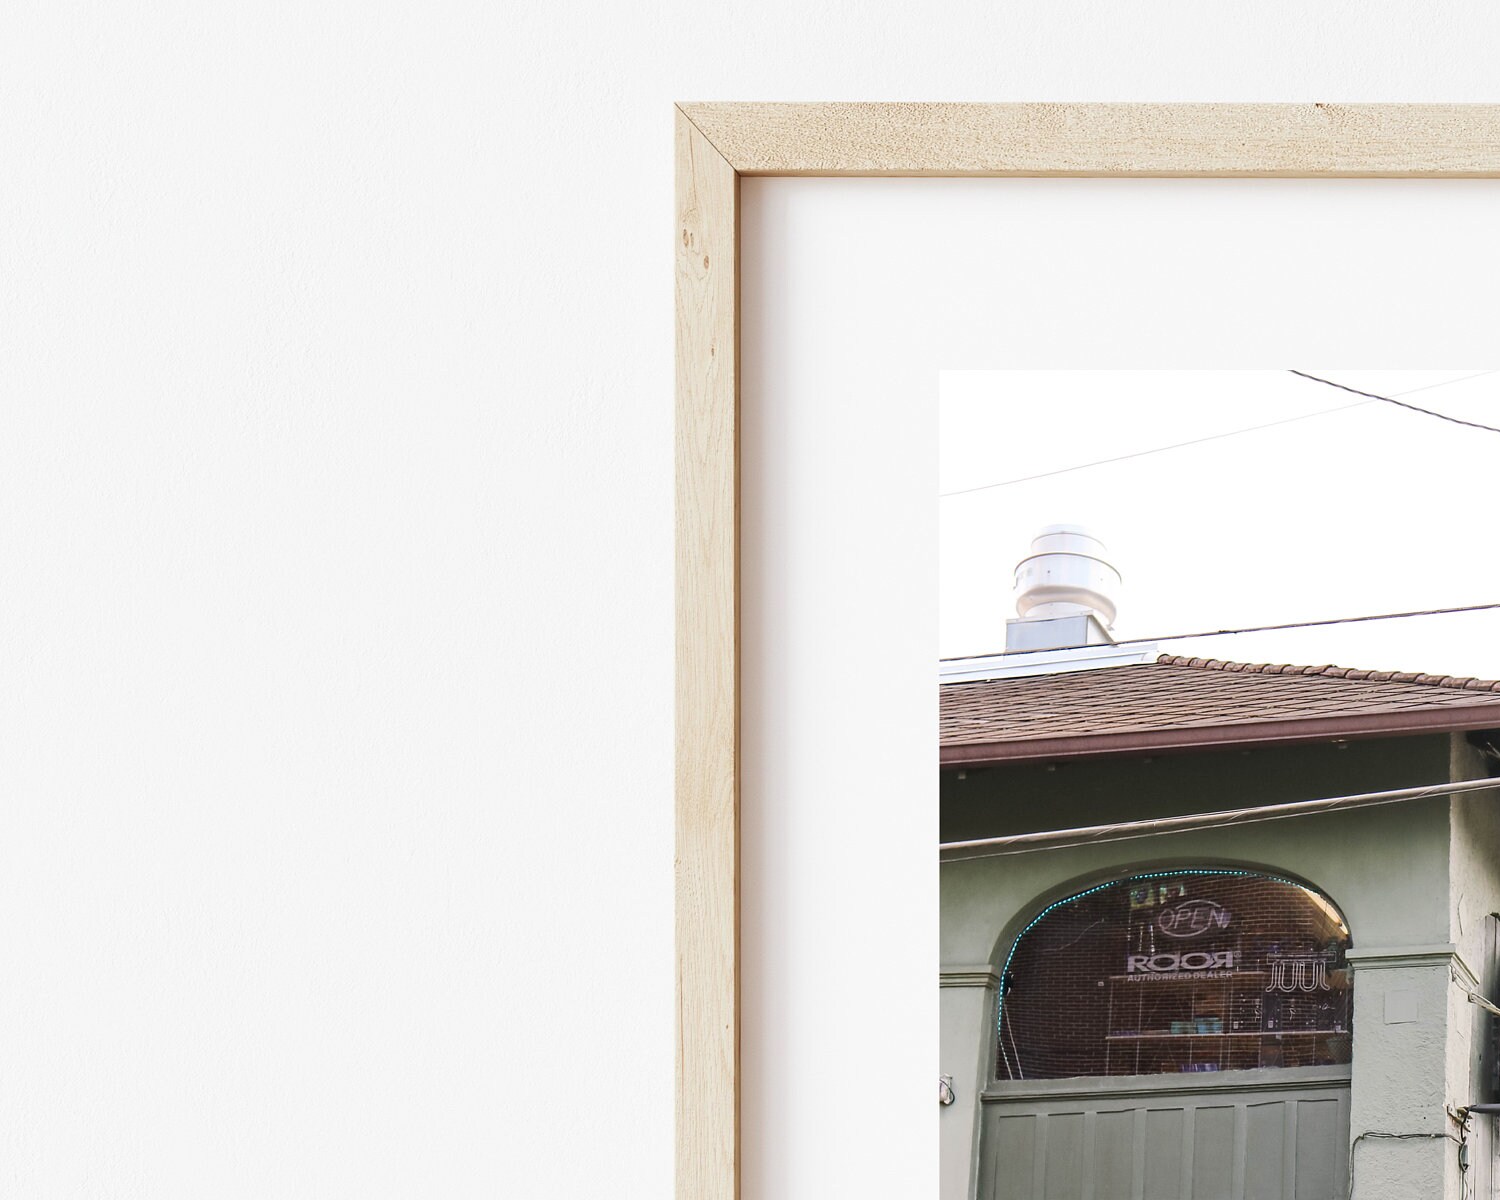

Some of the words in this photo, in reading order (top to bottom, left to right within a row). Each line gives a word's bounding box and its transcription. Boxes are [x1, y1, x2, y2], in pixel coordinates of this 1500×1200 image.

[1159, 908, 1225, 931] OPEN
[1127, 972, 1192, 982] AUTHORIZED
[1193, 970, 1233, 979] DEALER
